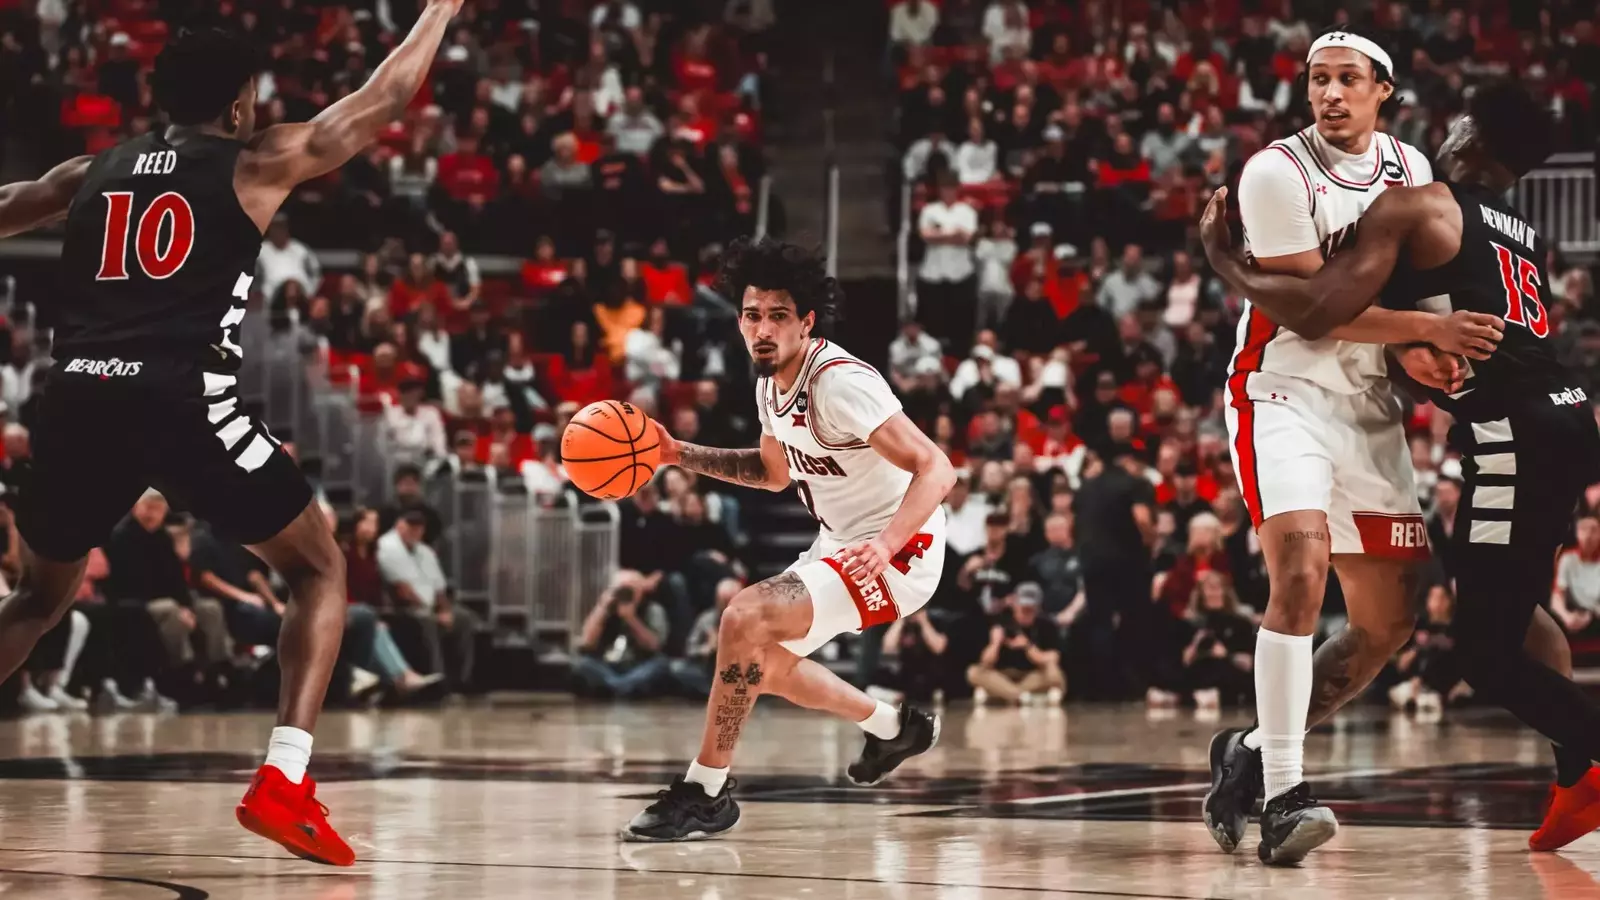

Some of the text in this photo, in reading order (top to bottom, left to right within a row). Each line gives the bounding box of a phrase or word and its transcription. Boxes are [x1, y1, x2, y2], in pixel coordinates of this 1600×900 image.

[132, 150, 177, 175] REED
[95, 191, 195, 280] 10
[1479, 203, 1526, 245] NEWMAN
[1488, 240, 1549, 338] 15
[64, 358, 144, 377] BEARCATS
[788, 444, 848, 477] TECH
[1284, 530, 1326, 543] HUMBLE
[1390, 521, 1426, 548] RED
